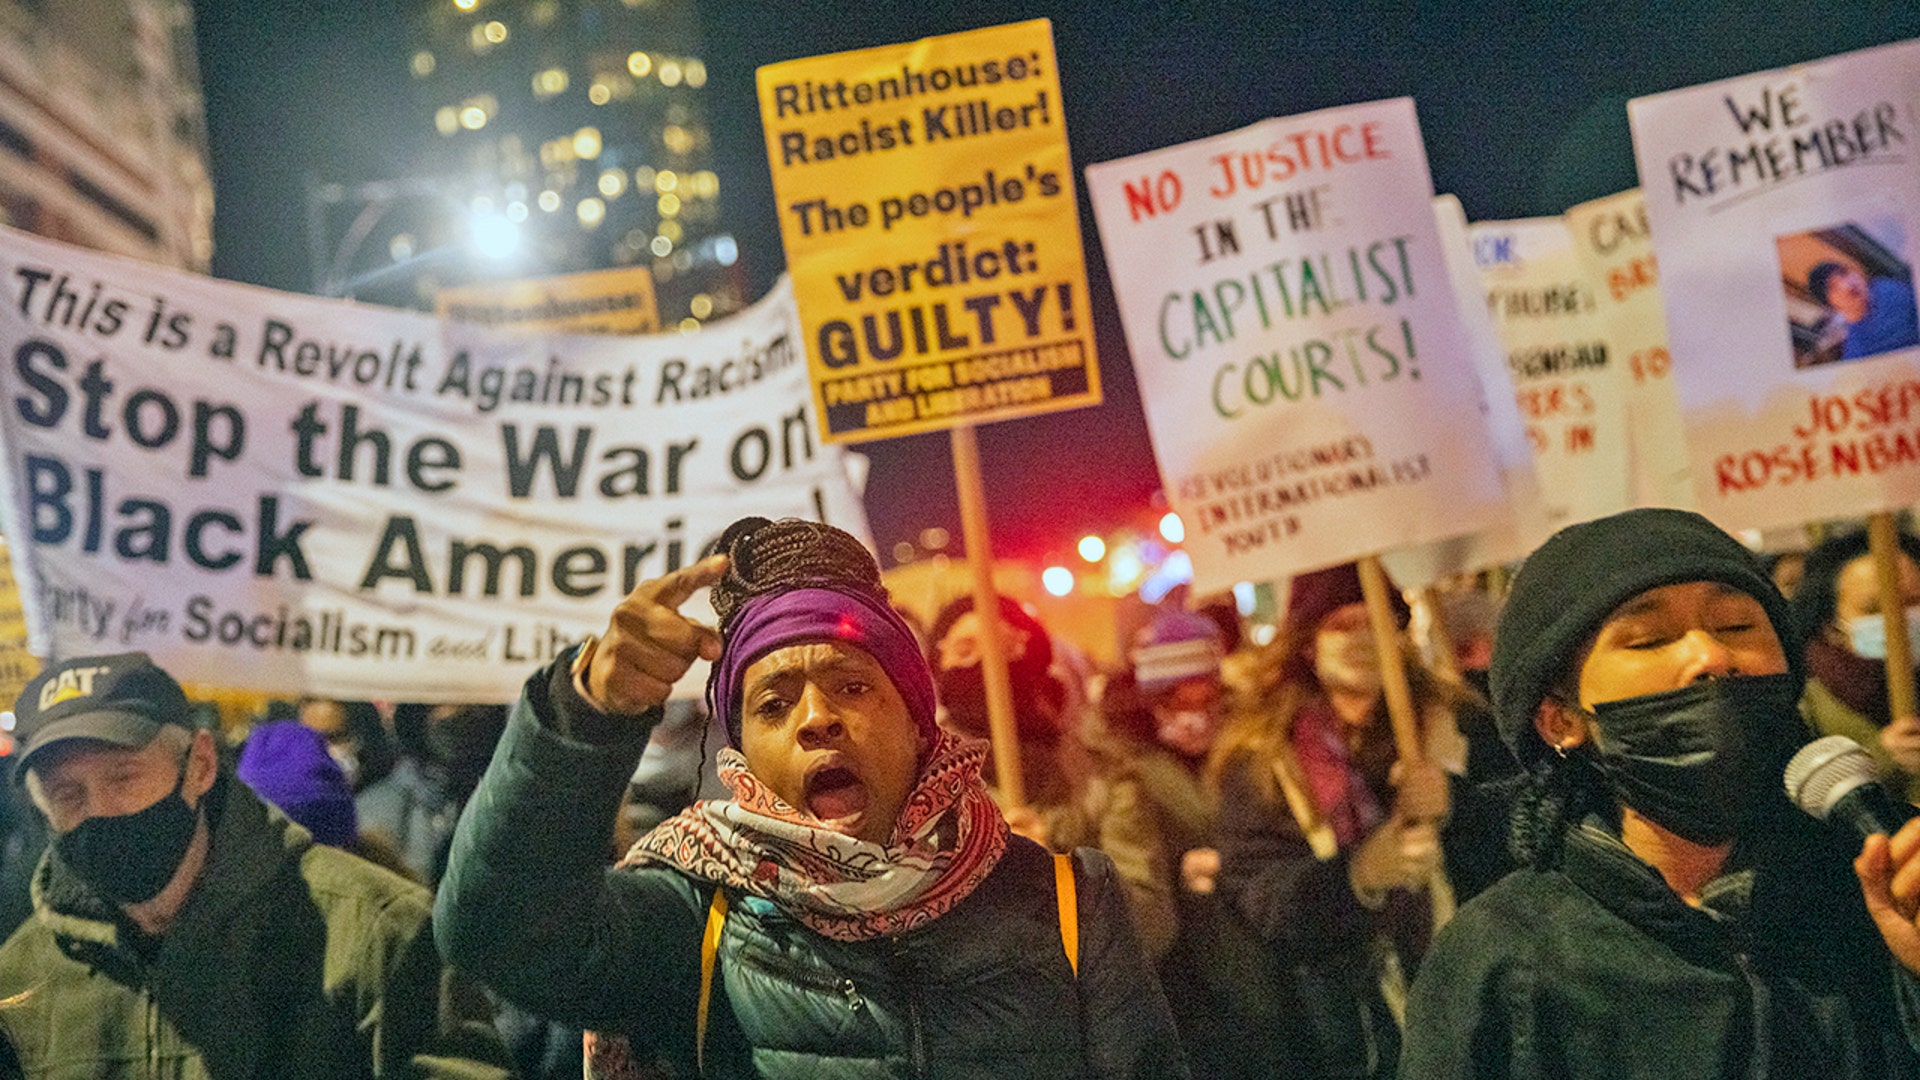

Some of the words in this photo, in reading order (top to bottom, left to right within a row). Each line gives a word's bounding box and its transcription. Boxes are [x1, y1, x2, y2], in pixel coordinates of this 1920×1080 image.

[774, 51, 1042, 119] Rittenhouse:
[1724, 82, 1808, 134] WE
[780, 118, 912, 167] Racist
[922, 90, 1051, 143] Killer!
[1669, 101, 1904, 204] REMEMBER
[790, 197, 870, 237] The
[880, 164, 1062, 231] people's
[1122, 168, 1183, 223] NO
[1209, 120, 1392, 199] JUSTICE
[836, 240, 1038, 302] verdict:
[1190, 217, 1241, 264] IN
[818, 282, 1077, 370] GUILTY!
[1158, 233, 1416, 361] CAPITALIST
[15, 266, 128, 337] This
[143, 295, 191, 350] is
[210, 321, 238, 359] a
[257, 319, 426, 394] Revolt
[438, 350, 637, 412] Against
[1211, 319, 1423, 418] COURTS!
[13, 339, 246, 478] Stop
[292, 402, 462, 492] the
[500, 422, 701, 498] War
[729, 403, 813, 483] on
[1714, 431, 1920, 496] ROSENBA
[24, 454, 314, 580] Black
[183, 594, 417, 657] Socialism
[38, 667, 98, 712] CAT
